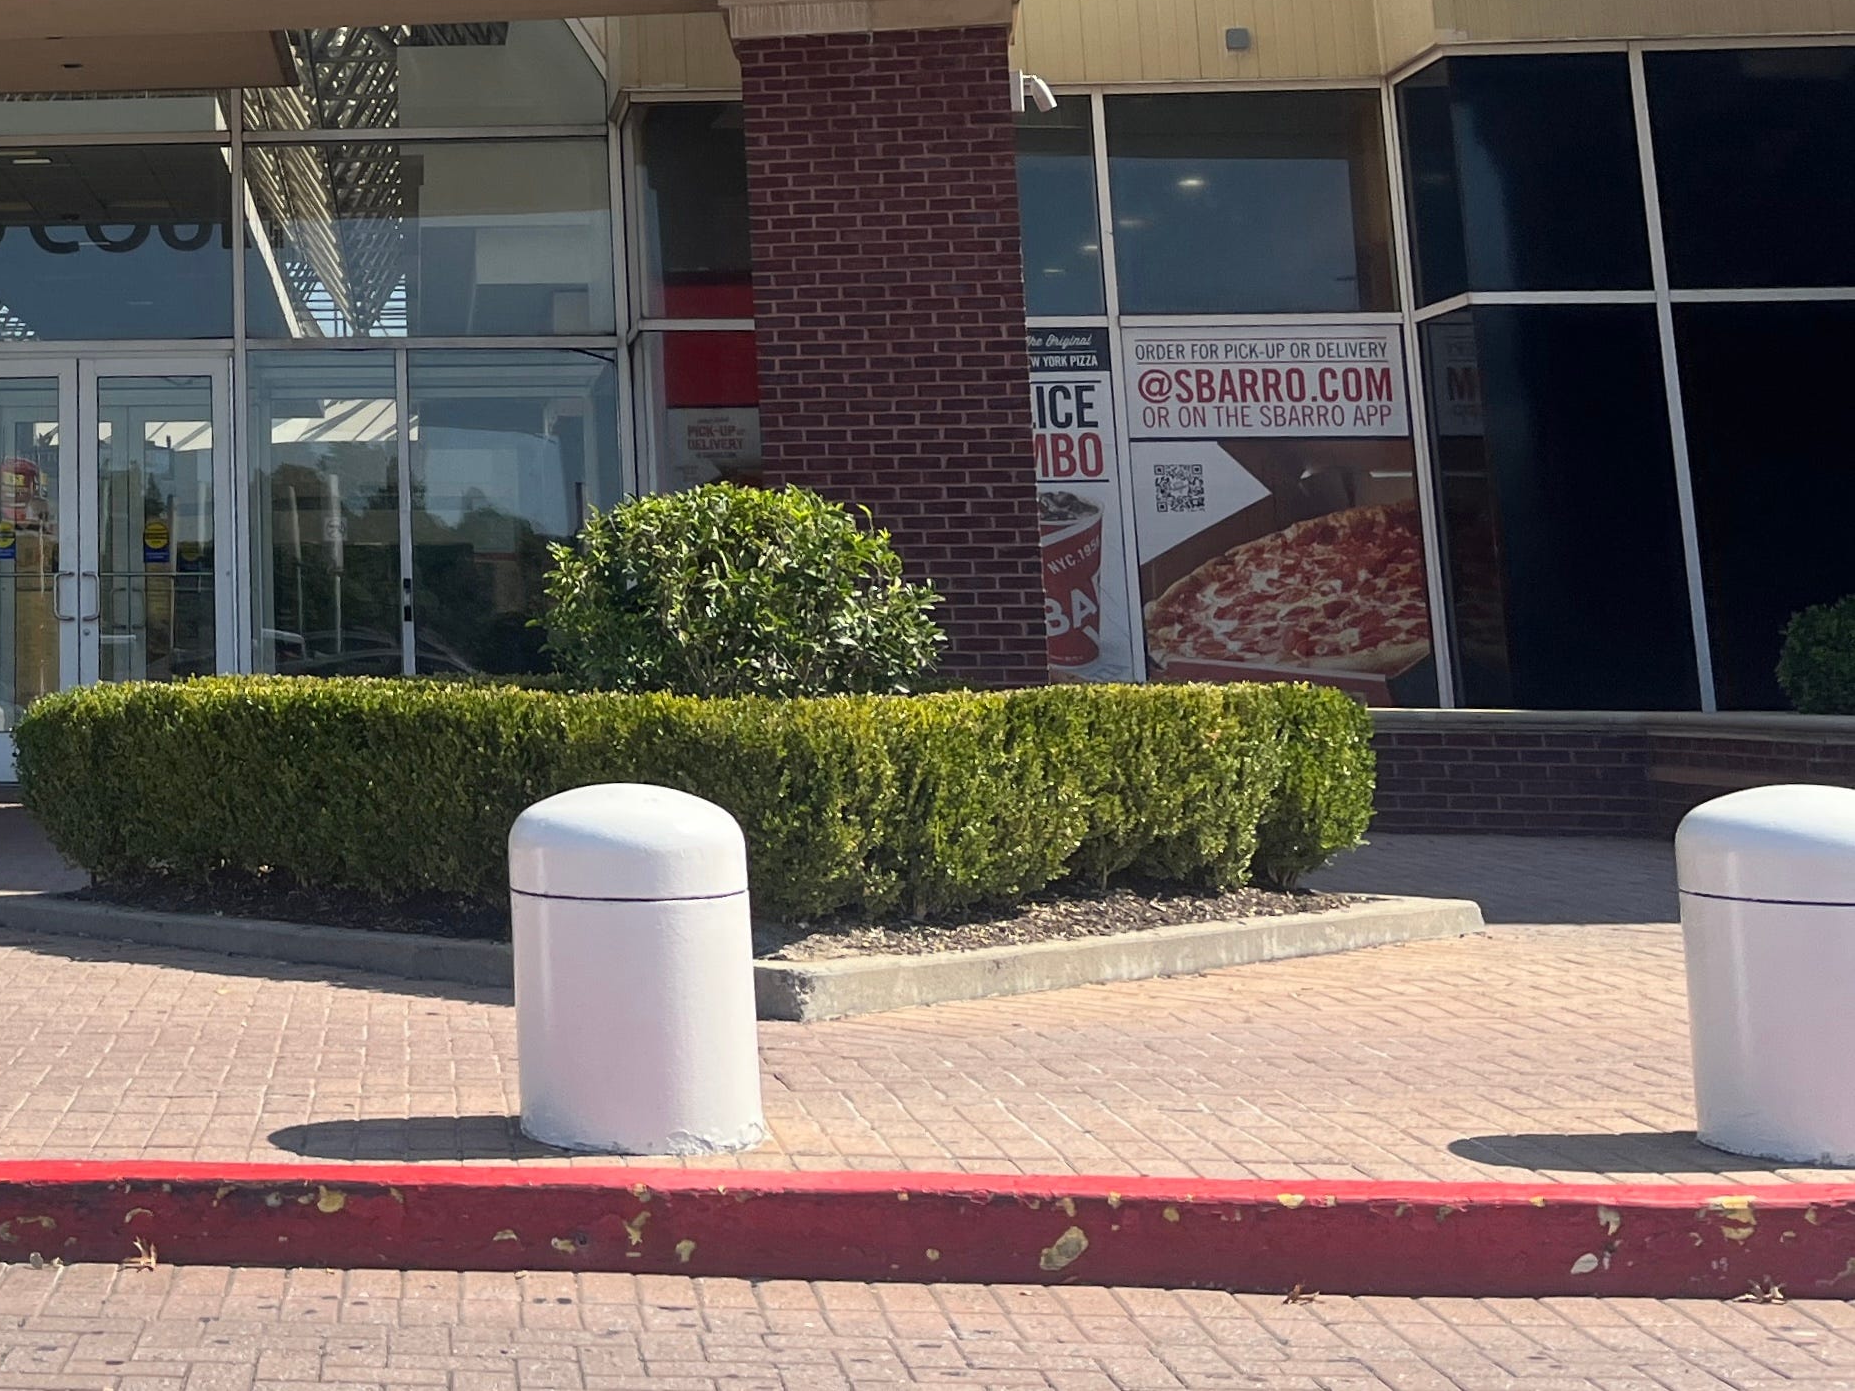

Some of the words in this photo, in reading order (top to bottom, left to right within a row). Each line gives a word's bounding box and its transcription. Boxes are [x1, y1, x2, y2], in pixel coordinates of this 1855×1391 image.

[1046, 334, 1092, 350] Original
[1135, 343, 1185, 360] ORDER
[1191, 343, 1219, 360] FOR
[1225, 341, 1285, 359] PICK-UP
[1290, 342, 1311, 359] OR
[1316, 341, 1388, 359] DELIVERY
[1043, 355, 1068, 368] YORK
[1070, 354, 1099, 367] PIZZA
[1138, 366, 1394, 404] @SBARRO.COM
[1033, 385, 1099, 429] ICE
[1143, 406, 1171, 429] OR
[1178, 406, 1207, 428] ON
[1213, 406, 1253, 428] THE
[1260, 405, 1346, 427] SBARRO
[1353, 405, 1393, 427] APP
[687, 425, 736, 437] PICK-UP
